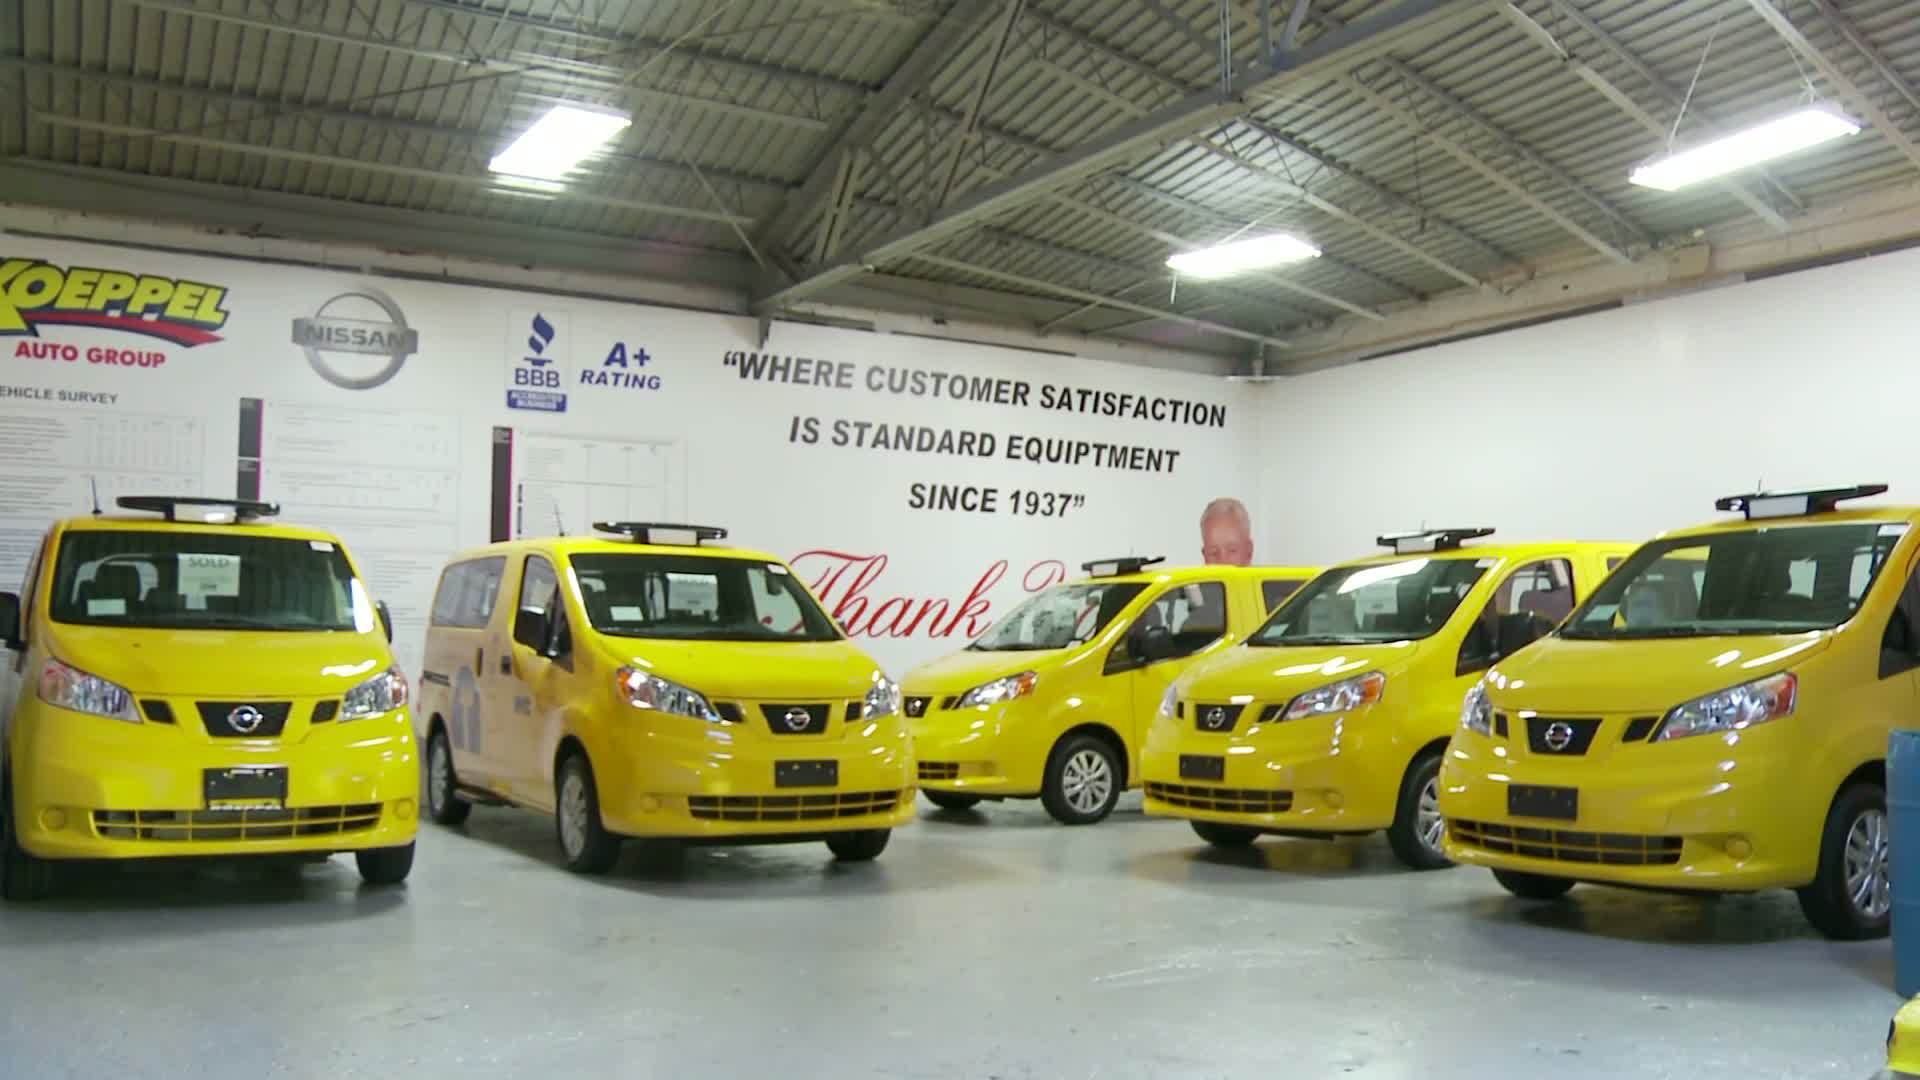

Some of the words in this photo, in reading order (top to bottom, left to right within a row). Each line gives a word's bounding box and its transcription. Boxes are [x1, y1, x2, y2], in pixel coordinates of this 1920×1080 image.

[304, 325, 404, 348] NISSAN
[15, 341, 79, 361] AUTO
[86, 347, 166, 368] GROUP
[604, 342, 650, 368] A+
[514, 367, 560, 388] BBB
[580, 369, 661, 390] RATING
[0, 385, 52, 401] EHICLE
[57, 389, 119, 404] SURVEY
[865, 365, 1031, 407] CUSTOMER
[1039, 384, 1227, 428] SATISFACTION
[789, 415, 820, 444] IS
[831, 419, 996, 458] STANDARD
[1005, 434, 1181, 473] EQUIPTMENT
[908, 483, 998, 513] SINCE
[788, 550, 1008, 638] Thank
